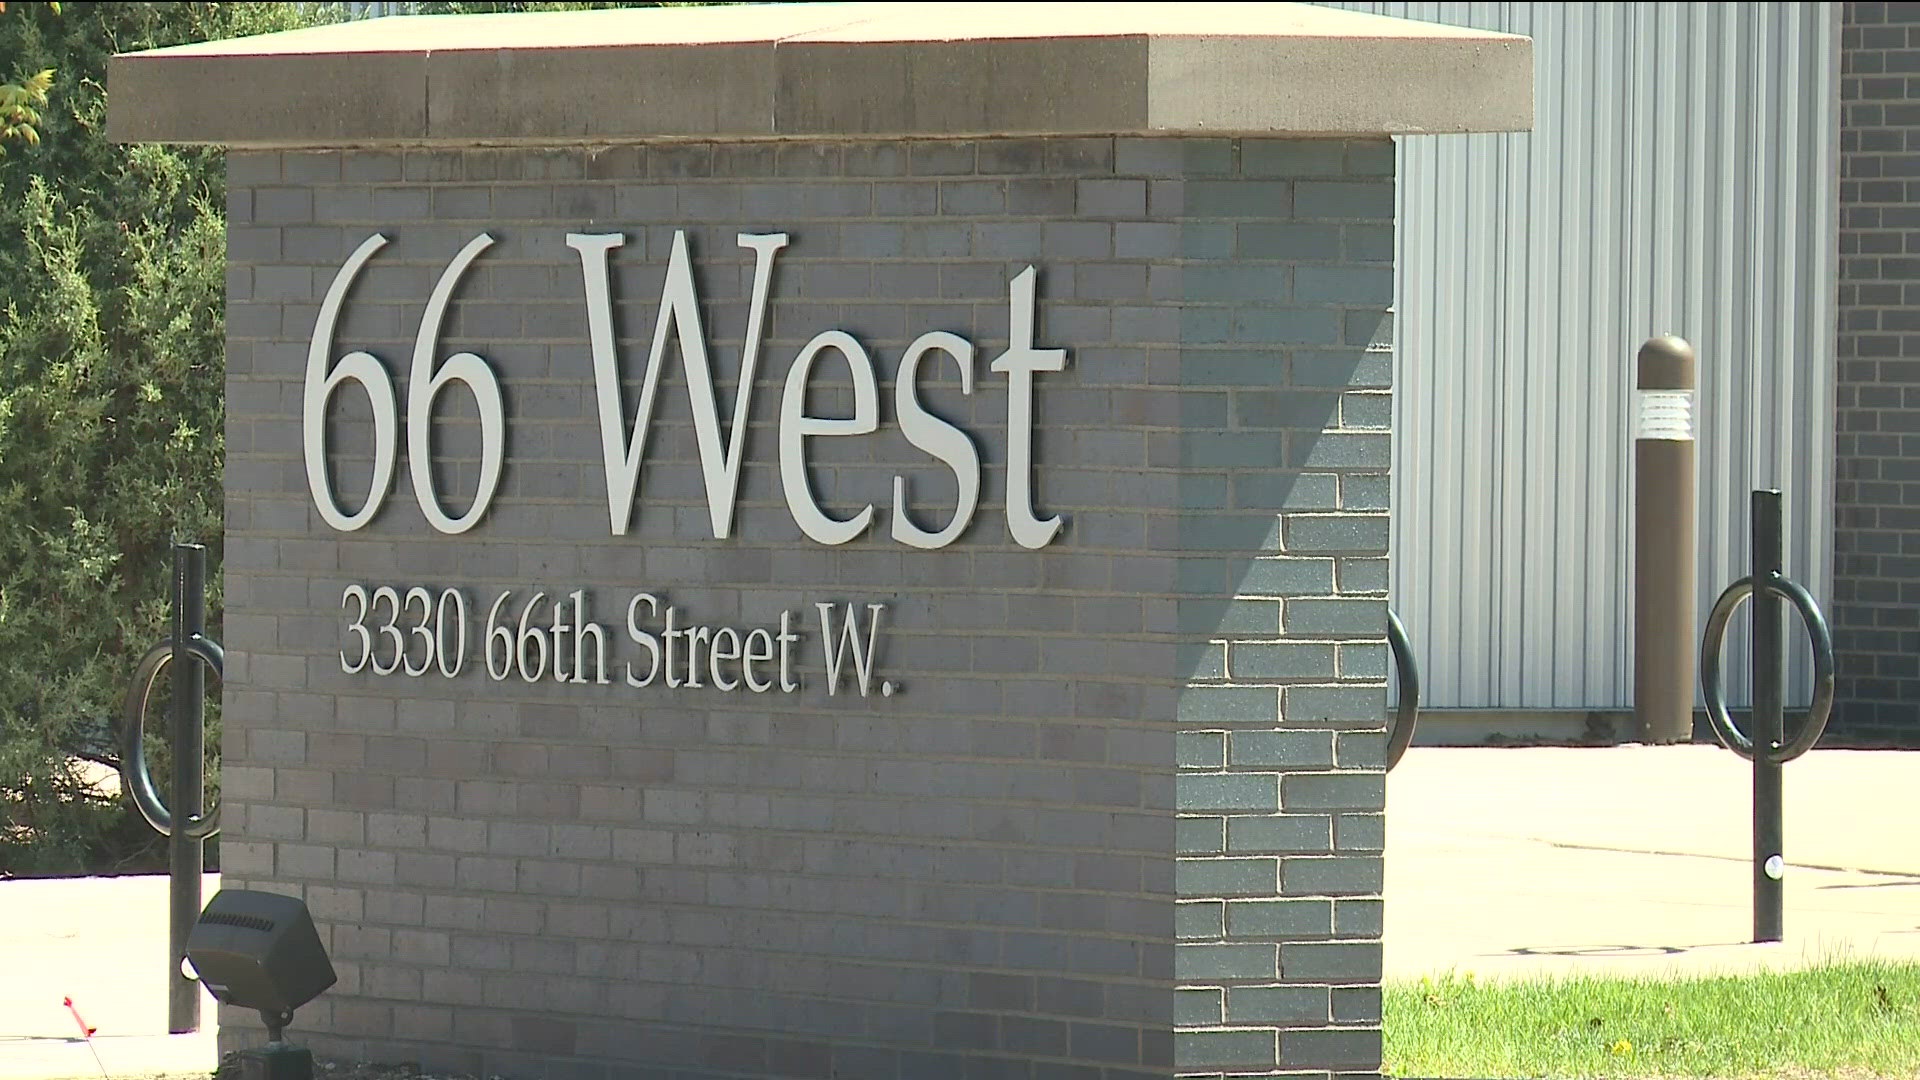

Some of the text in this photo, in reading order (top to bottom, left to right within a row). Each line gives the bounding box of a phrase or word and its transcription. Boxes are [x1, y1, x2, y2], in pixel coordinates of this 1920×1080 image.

[303, 230, 1066, 549] 66 West
[339, 584, 893, 698] 3330 66th Street W.
